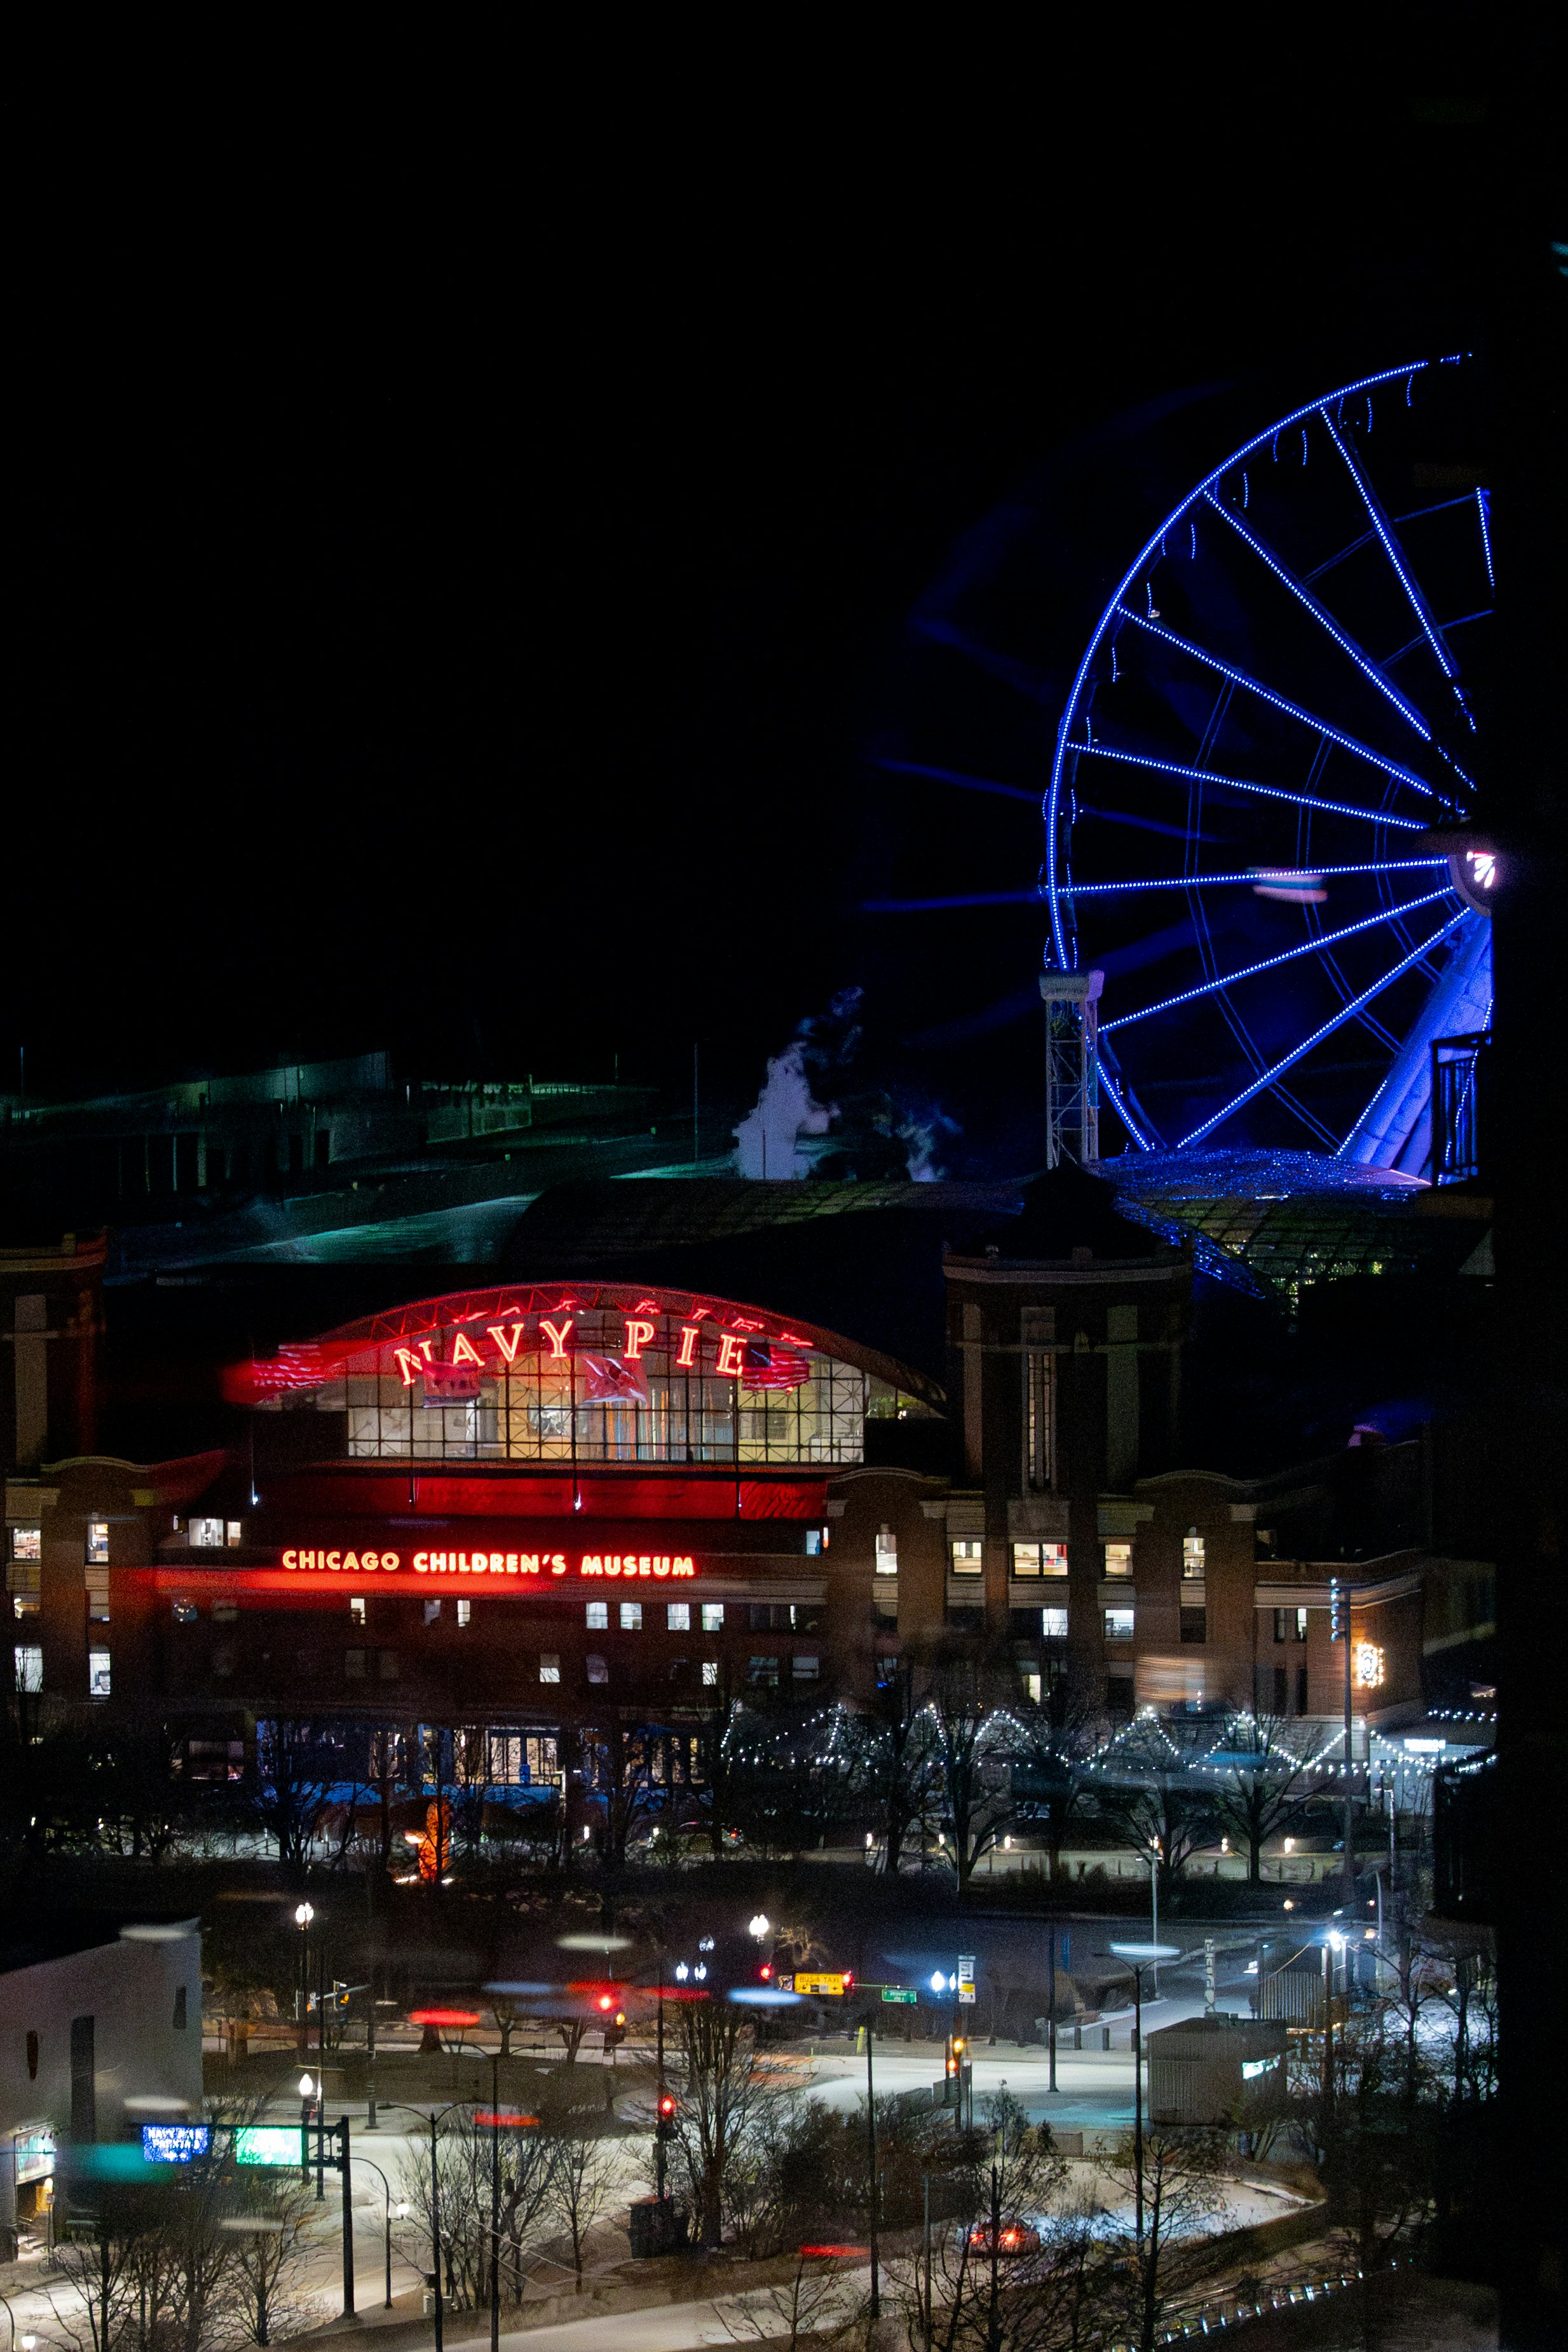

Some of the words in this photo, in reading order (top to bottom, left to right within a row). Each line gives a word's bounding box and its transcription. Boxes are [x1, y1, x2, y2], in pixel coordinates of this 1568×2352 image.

[393, 1320, 572, 1386] NAVY
[624, 1320, 747, 1376] PIE
[282, 1550, 400, 1571] CHICAGO
[413, 1552, 567, 1575] CHILDREN'S
[580, 1555, 695, 1576] MUSEUM
